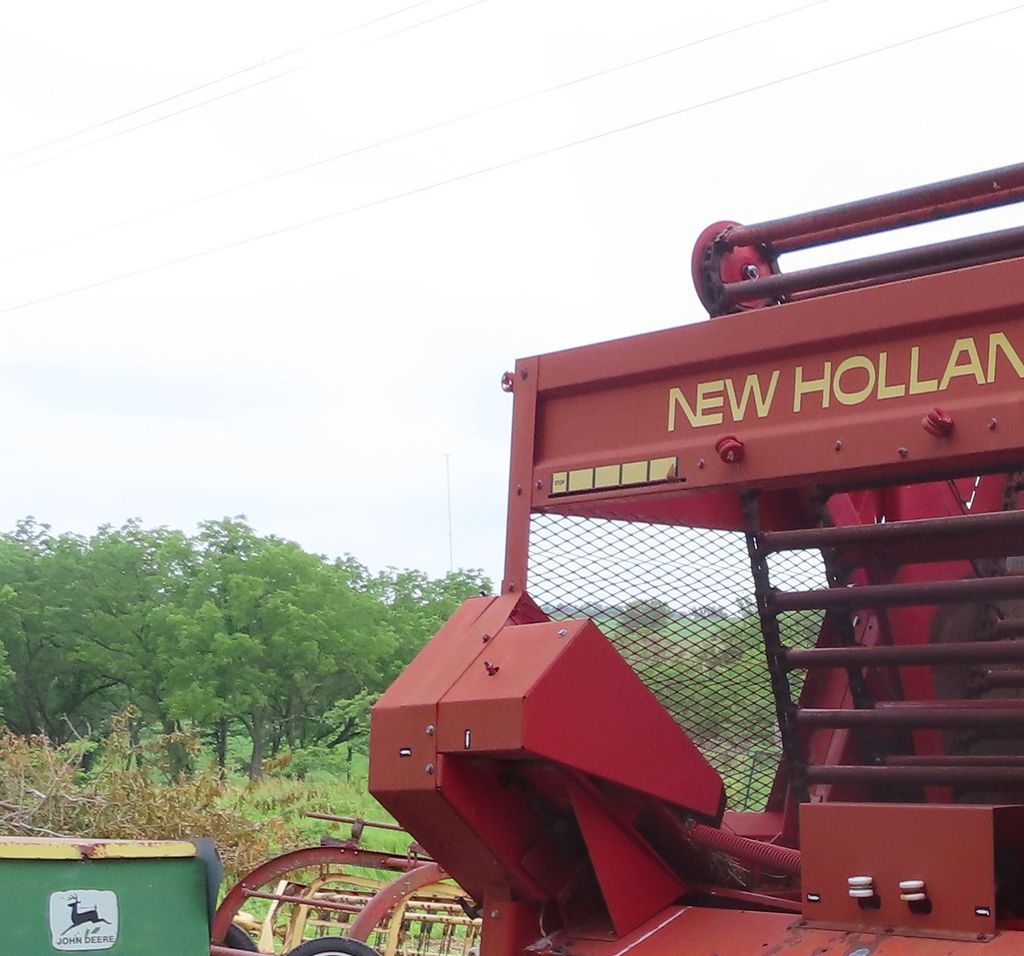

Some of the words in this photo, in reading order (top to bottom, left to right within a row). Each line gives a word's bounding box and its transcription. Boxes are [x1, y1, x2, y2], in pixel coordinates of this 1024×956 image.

[667, 369, 781, 431] NEW
[56, 937, 82, 945] JOHN
[84, 936, 115, 944] DEERE
